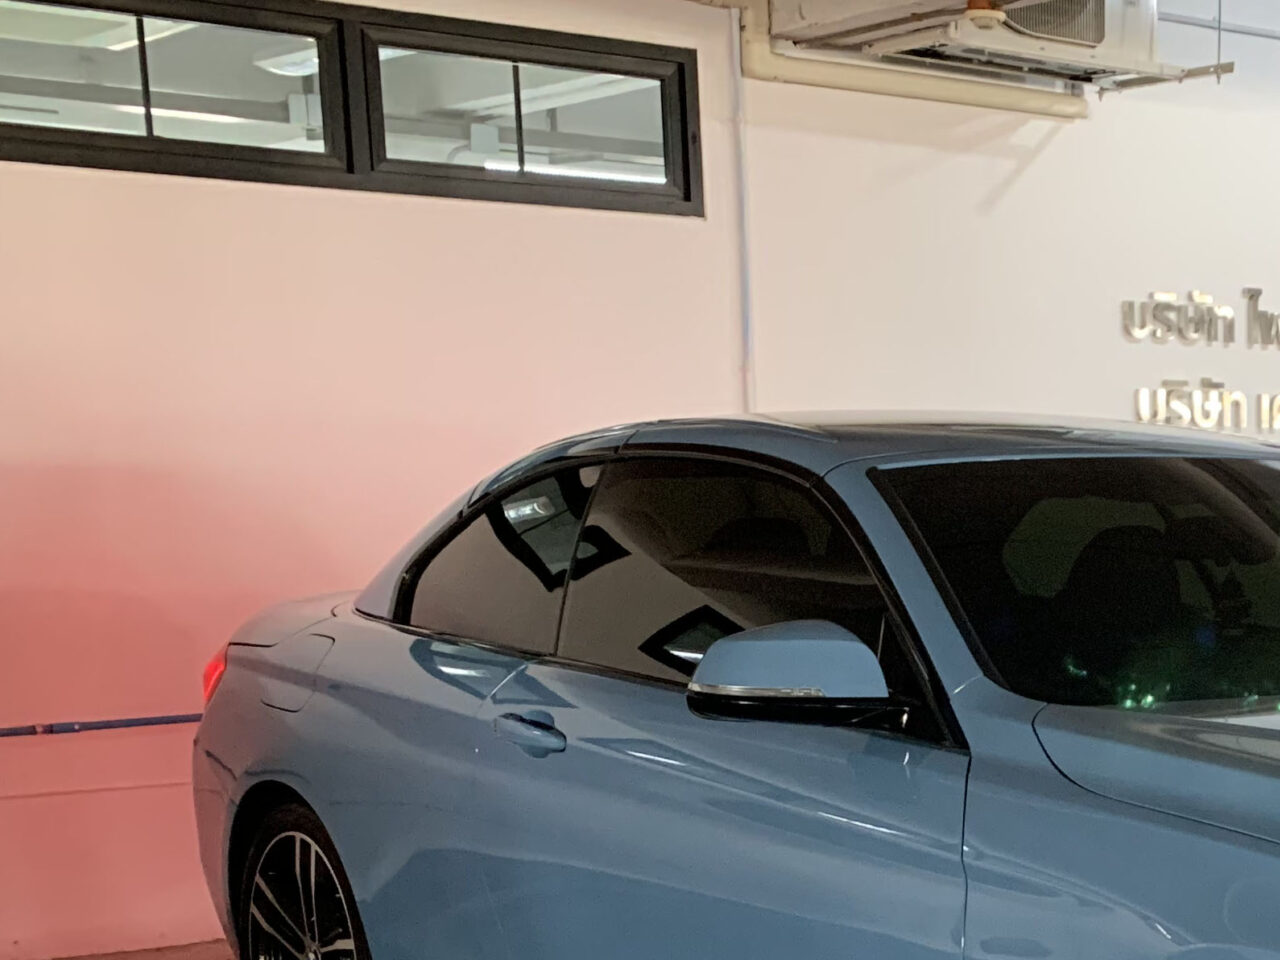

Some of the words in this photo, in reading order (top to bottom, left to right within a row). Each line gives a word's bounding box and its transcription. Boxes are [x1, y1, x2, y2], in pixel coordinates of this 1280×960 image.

[1122, 290, 1235, 346] บริษัท
[1136, 378, 1247, 428] บริษัท
